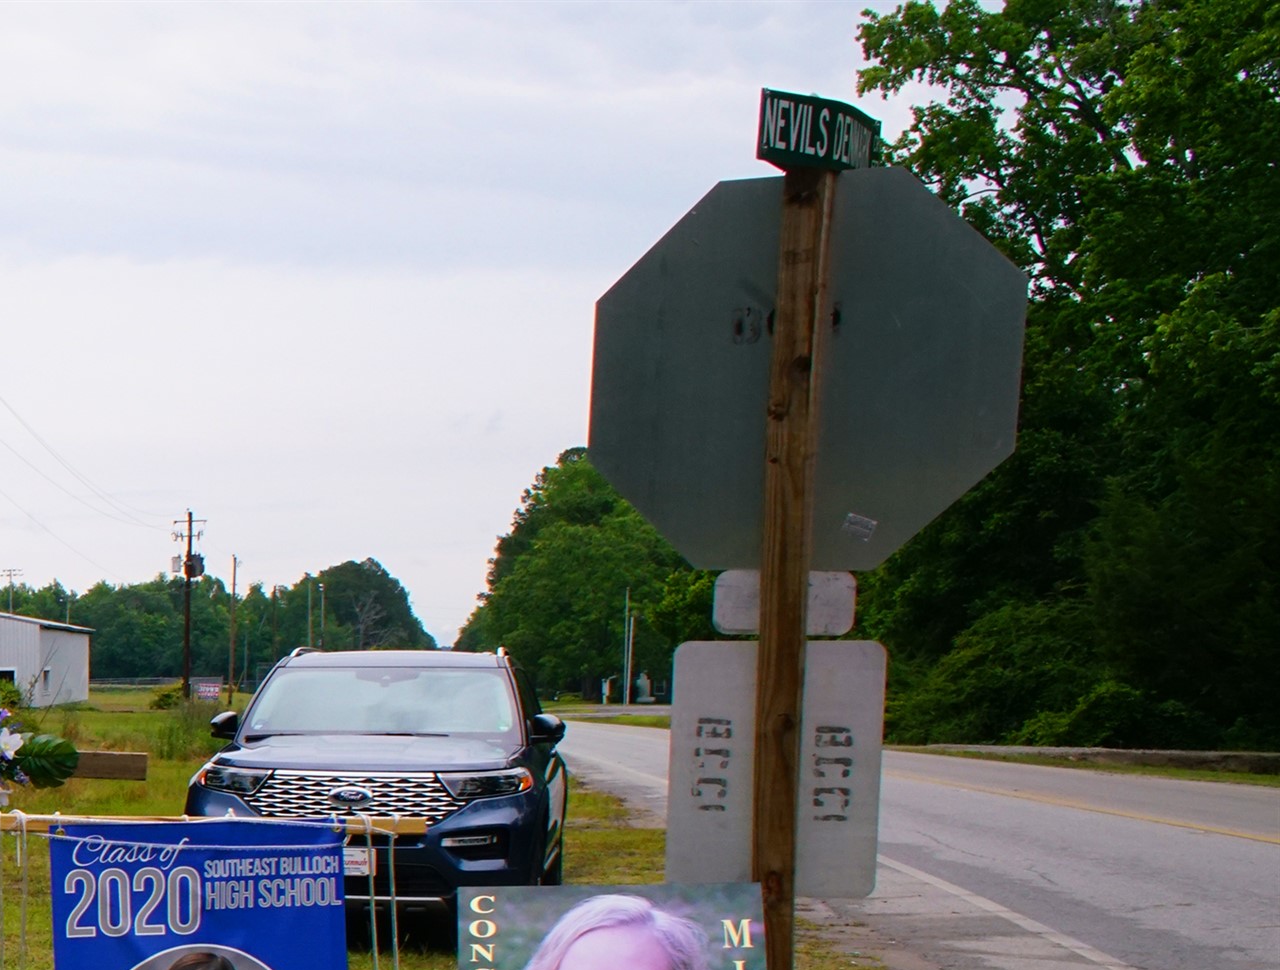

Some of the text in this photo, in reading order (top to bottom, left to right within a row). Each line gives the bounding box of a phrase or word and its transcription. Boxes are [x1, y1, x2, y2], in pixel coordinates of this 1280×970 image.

[762, 97, 830, 158] NEVILS
[71, 835, 190, 870] Class of
[204, 857, 278, 878] SOUTHEAST
[280, 855, 340, 875] BULLOCH
[64, 866, 201, 938] 2020
[205, 877, 342, 910] HIGH SCHOOL
